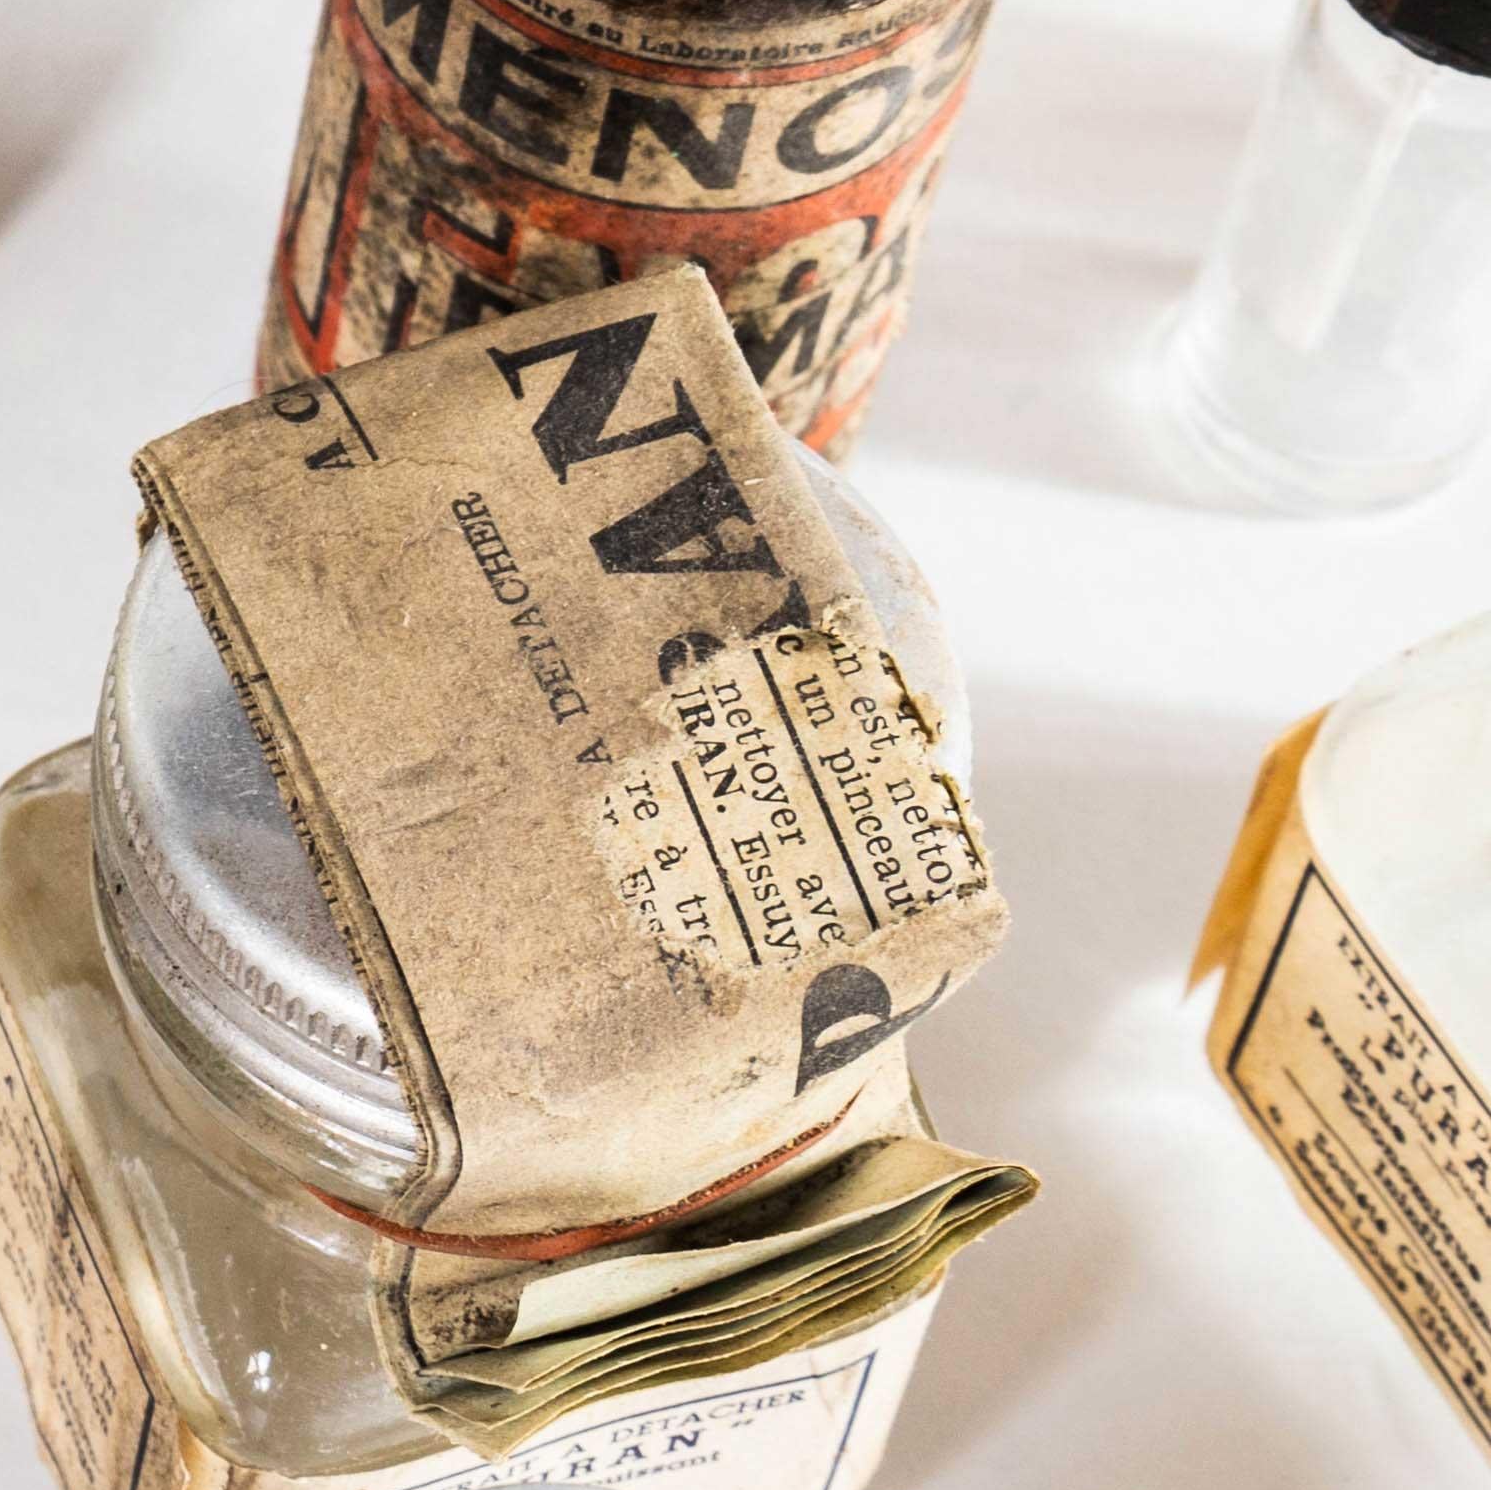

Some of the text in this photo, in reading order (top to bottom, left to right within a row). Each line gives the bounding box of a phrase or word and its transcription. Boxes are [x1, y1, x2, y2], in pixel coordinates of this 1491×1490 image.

[637, 29, 826, 63] Laboratoire
[453, 490, 614, 769] A DETACHER
[795, 672, 836, 730] un
[849, 696, 901, 765] est,
[712, 678, 807, 847] nettoyer
[653, 843, 688, 872] à
[1337, 934, 1431, 1060] EXTRAIT
[563, 1440, 586, 1458] A
[608, 1387, 808, 1446] DETACHER
